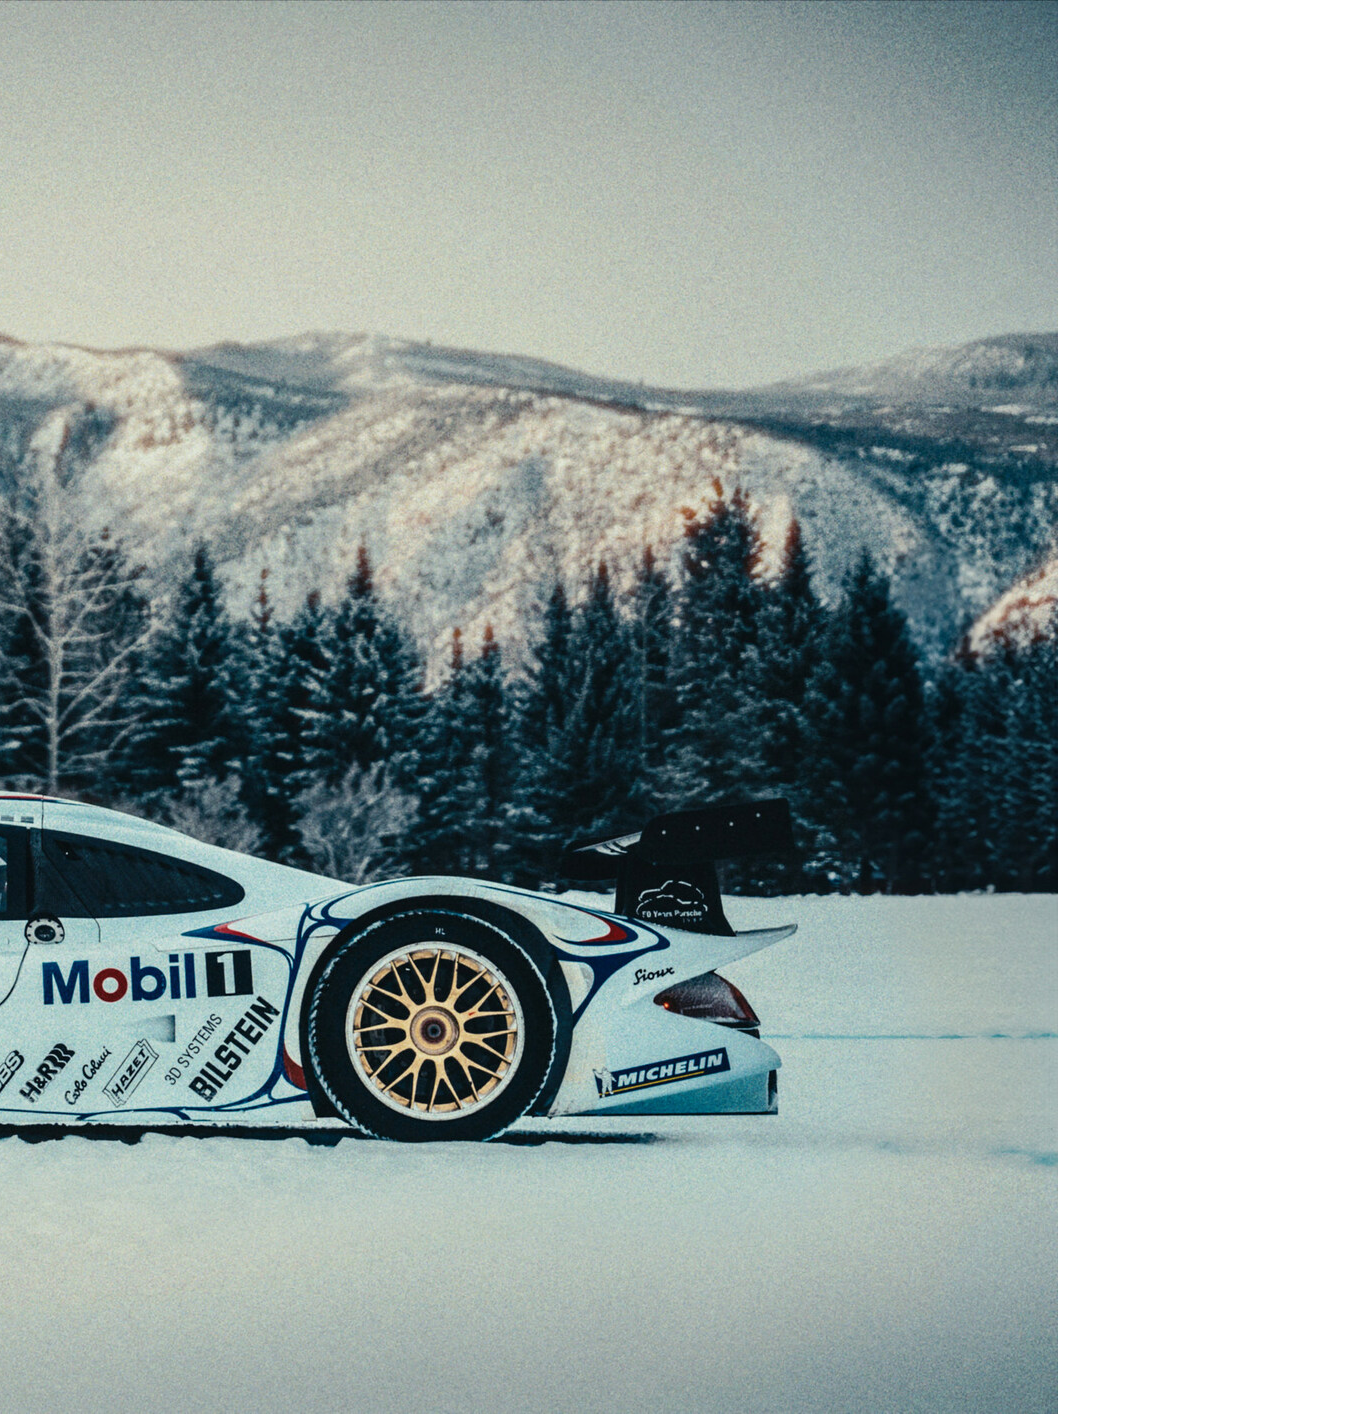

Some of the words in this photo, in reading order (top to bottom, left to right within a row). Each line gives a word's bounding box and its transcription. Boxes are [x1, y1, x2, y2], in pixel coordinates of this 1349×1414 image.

[42, 953, 197, 1005] Mobil
[633, 967, 675, 985] Sioux
[111, 1048, 146, 1099] HAZET
[164, 1067, 182, 1086] 3D
[177, 1013, 223, 1068] SYSTEMS
[188, 996, 281, 1102] BILSTEIN
[617, 1052, 723, 1088] MICHELIN
